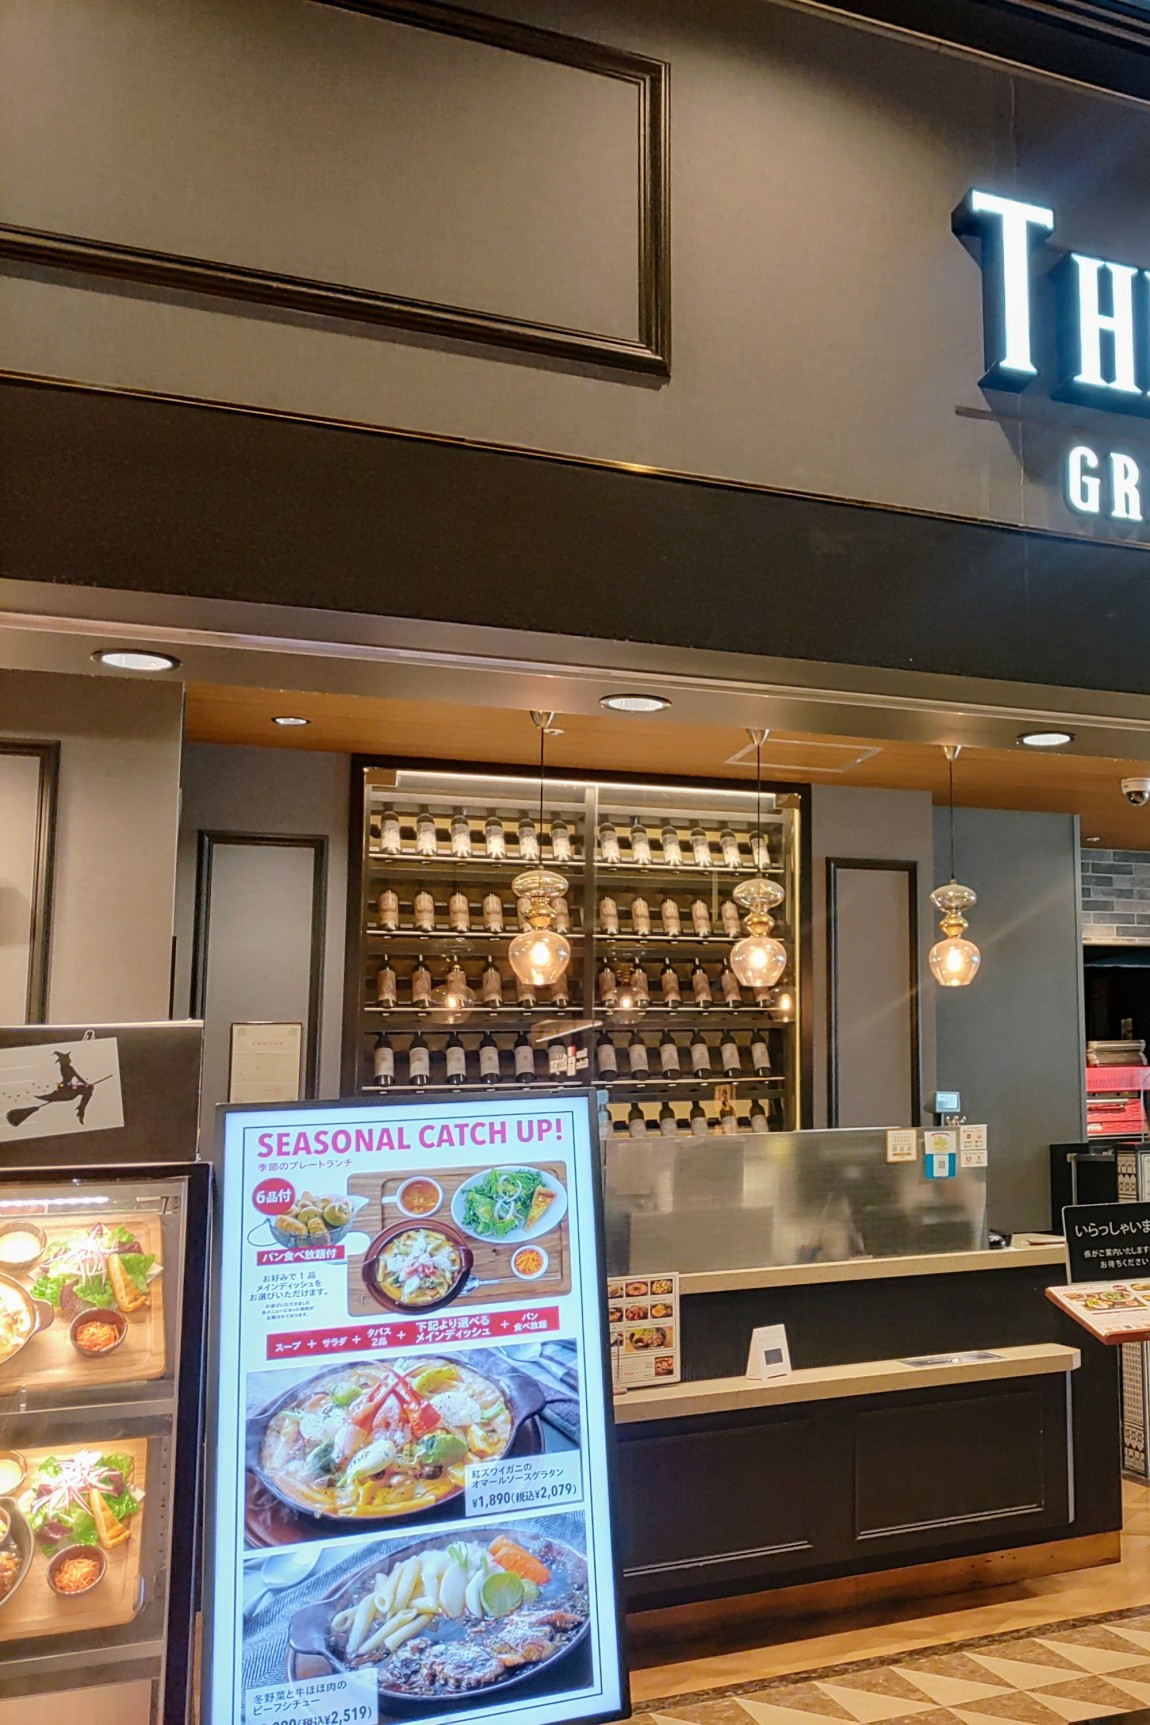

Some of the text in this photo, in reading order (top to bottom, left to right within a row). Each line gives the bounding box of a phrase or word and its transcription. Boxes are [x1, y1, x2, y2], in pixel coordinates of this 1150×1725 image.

[257, 1118, 563, 1158] SEASONAL CATCH UP!
[257, 1158, 353, 1172] 季節のプレートランチ
[255, 1188, 292, 1204] 6品付
[262, 1248, 338, 1263] パン食べ放題付
[1100, 1258, 1150, 1269] お待ちください
[256, 1279, 322, 1292] メインディッシュを
[415, 1315, 491, 1333] 下記より選べる
[521, 1312, 539, 1321] パン
[275, 1341, 302, 1352] スープ
[322, 1335, 348, 1348] サラダ
[415, 1326, 491, 1344] メインディッシュ
[513, 1320, 547, 1332] 食べ放題
[471, 1469, 564, 1489] オマールソースグラタン
[472, 1463, 532, 1479] 紅ズワイガニの
[254, 1680, 347, 1704] 冬野菜と牛ほほ肉の
[253, 1698, 321, 1716] ビーフシチュー
